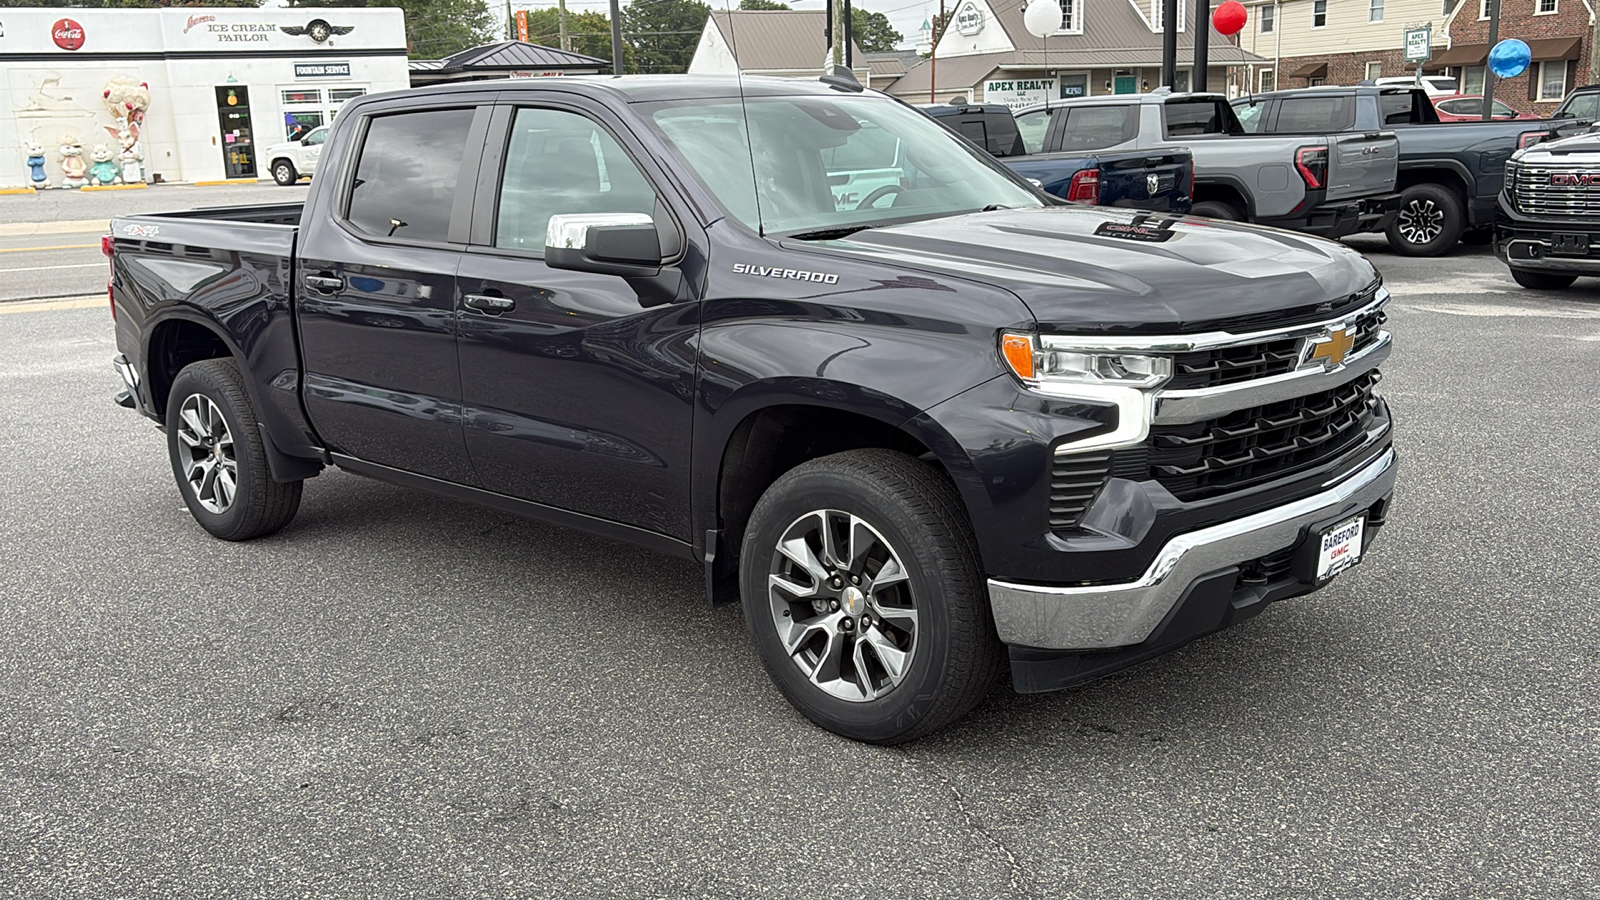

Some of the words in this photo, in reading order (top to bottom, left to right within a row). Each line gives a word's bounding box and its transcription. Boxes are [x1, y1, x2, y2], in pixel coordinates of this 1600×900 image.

[208, 24, 228, 32] ICE
[231, 24, 276, 32] CREAM
[218, 34, 268, 42] PARLOR
[296, 66, 325, 75] FOUNTAIN
[325, 65, 349, 74] SERVICE
[988, 81, 1014, 91] APEX
[1017, 80, 1054, 91] REALTY
[1552, 174, 1600, 186] GMC
[833, 193, 859, 206] MC
[732, 263, 839, 285] SILVERADO
[1324, 524, 1359, 552] BAREFORD
[1331, 544, 1349, 560] GMC
